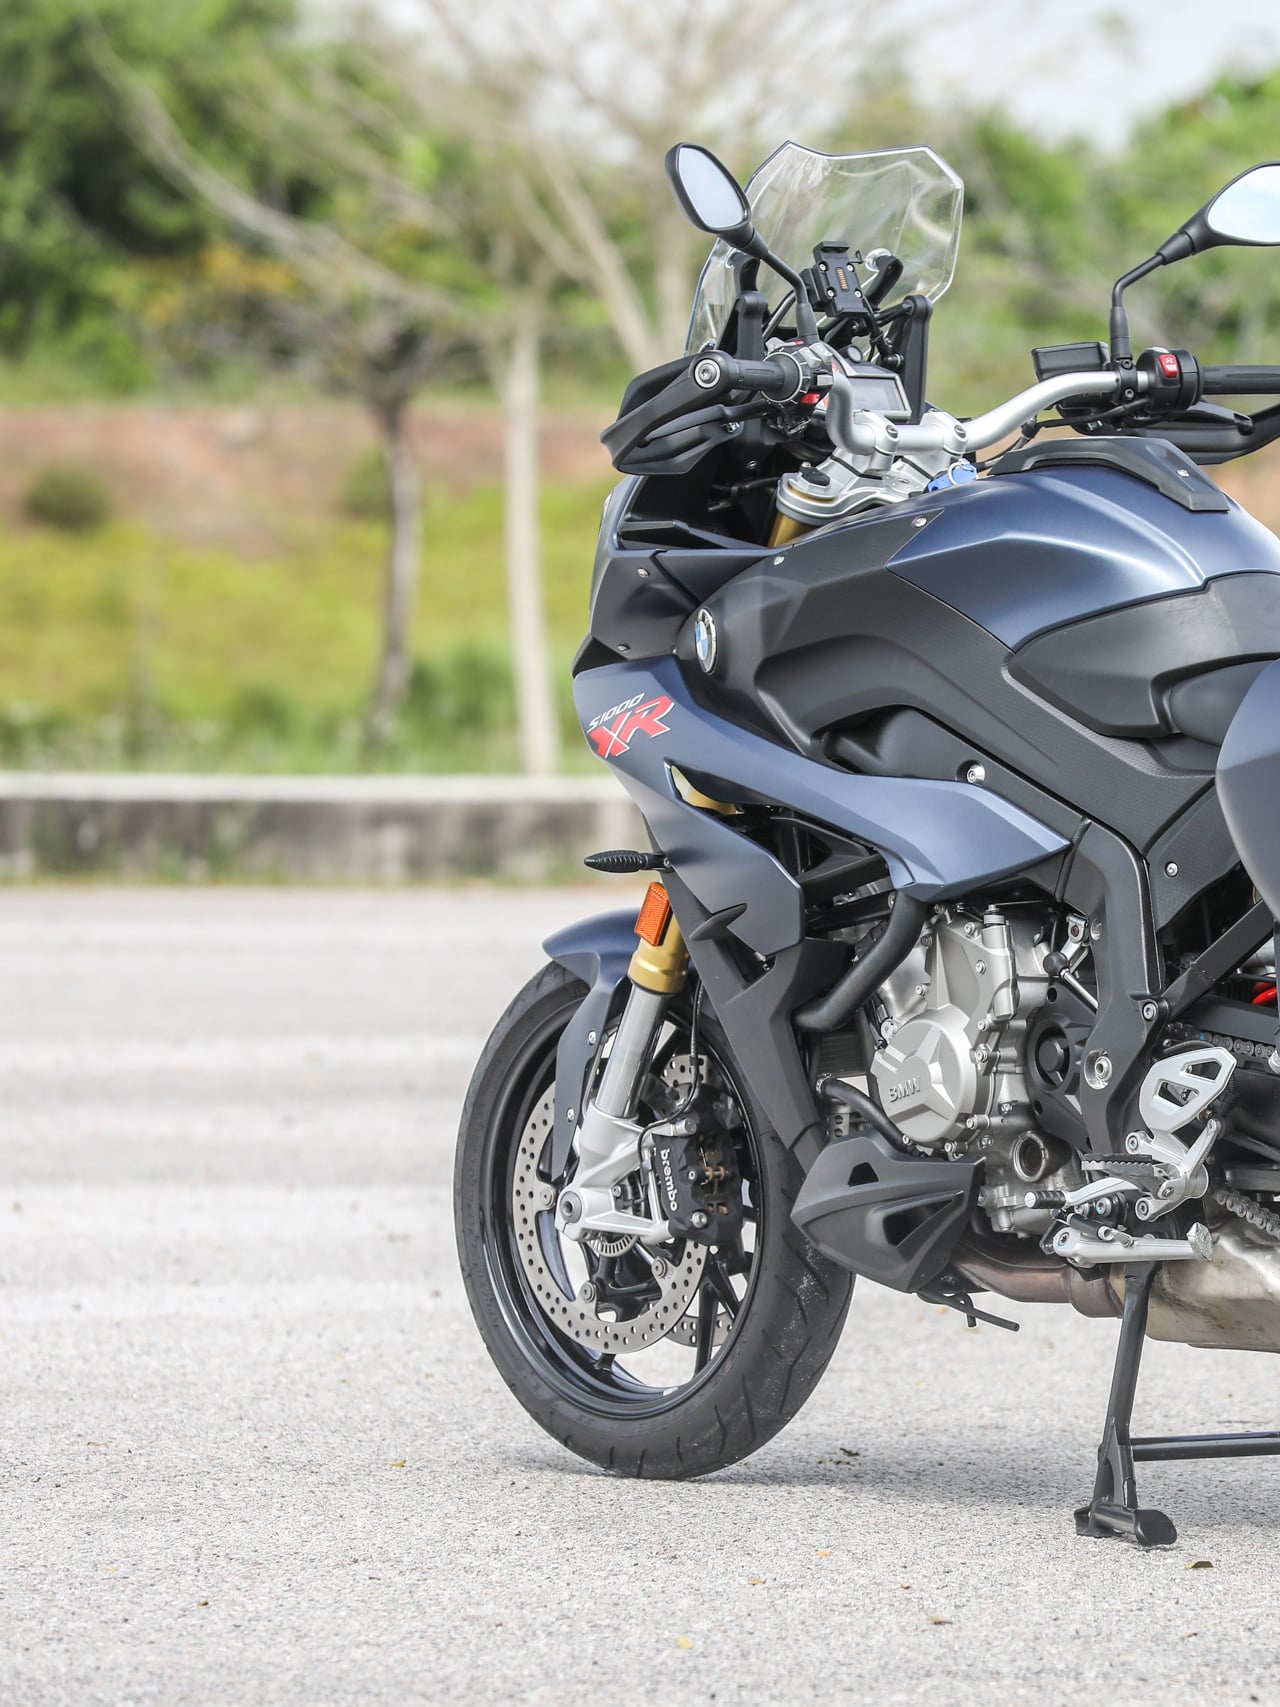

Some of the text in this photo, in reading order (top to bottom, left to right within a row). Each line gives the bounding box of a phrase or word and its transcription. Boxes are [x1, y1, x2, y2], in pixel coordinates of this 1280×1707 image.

[587, 692, 646, 733] S1000
[588, 695, 675, 758] XR
[888, 1075, 921, 1103] BMW
[660, 1148, 678, 1212] brembo
